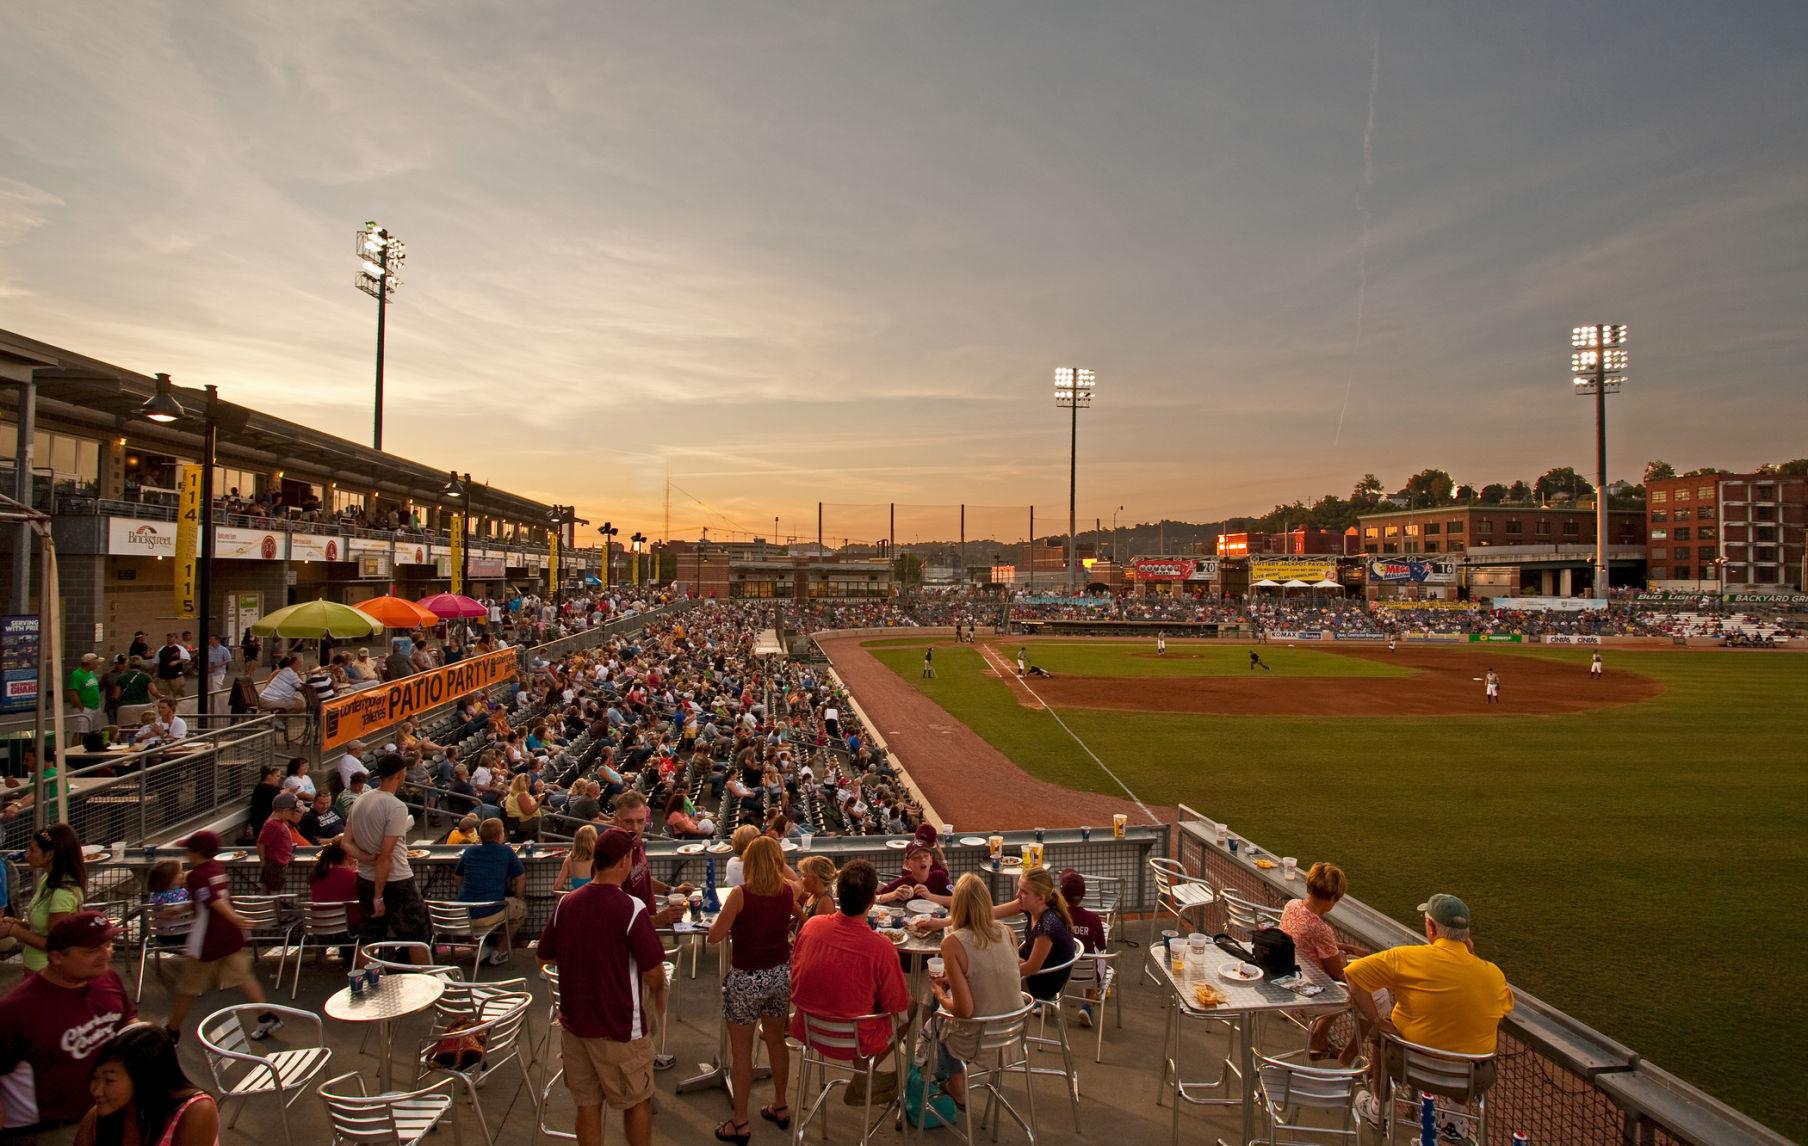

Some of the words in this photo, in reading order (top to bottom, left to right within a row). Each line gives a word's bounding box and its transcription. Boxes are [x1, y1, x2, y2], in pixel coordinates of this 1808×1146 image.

[1202, 563, 1215, 572] 20
[1386, 564, 1410, 573] MEGA
[1441, 564, 1453, 573] 16
[1735, 594, 1789, 602] BACKYARD
[11, 619, 39, 627] SERVING
[389, 671, 442, 719] PATIO
[447, 661, 490, 698] PARTY
[340, 694, 386, 717] contemporary
